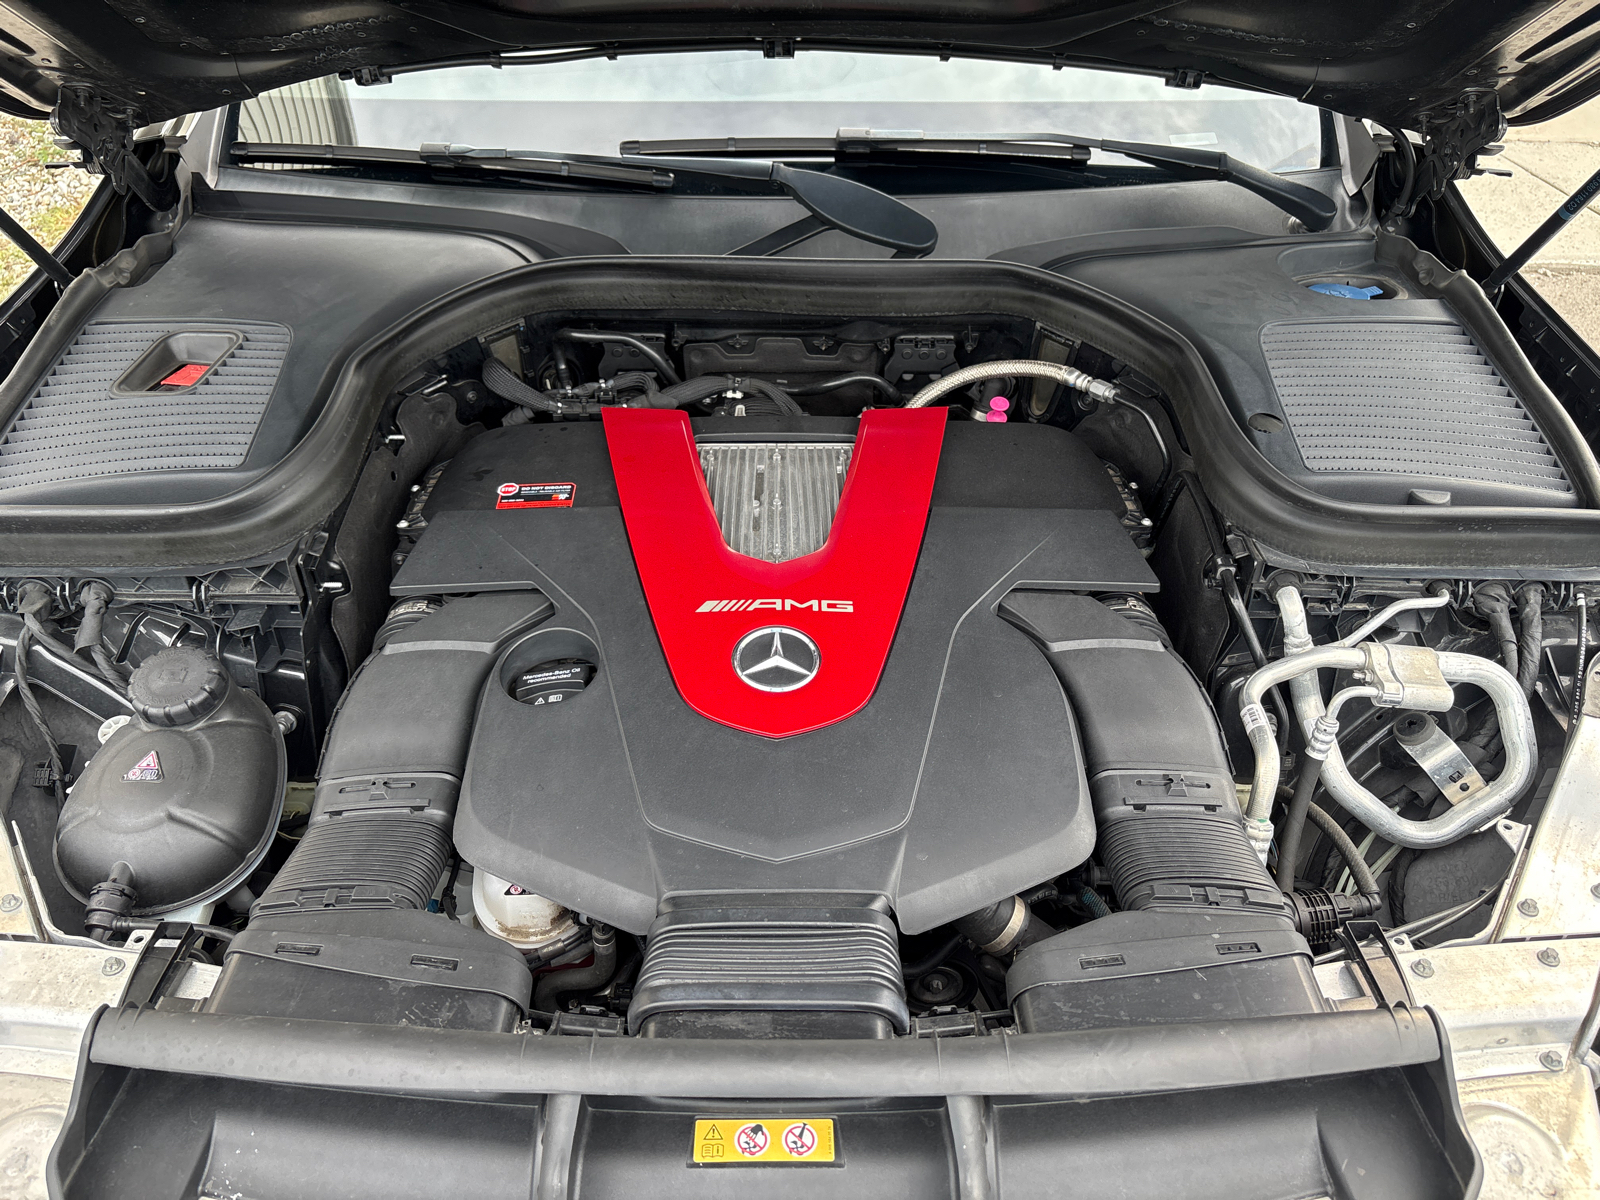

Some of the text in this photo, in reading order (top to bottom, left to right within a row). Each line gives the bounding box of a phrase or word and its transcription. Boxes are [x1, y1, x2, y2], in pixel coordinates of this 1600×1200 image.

[745, 598, 854, 613] AMG
[522, 669, 570, 680] Mercedes-Benz
[527, 673, 572, 684] recommended
